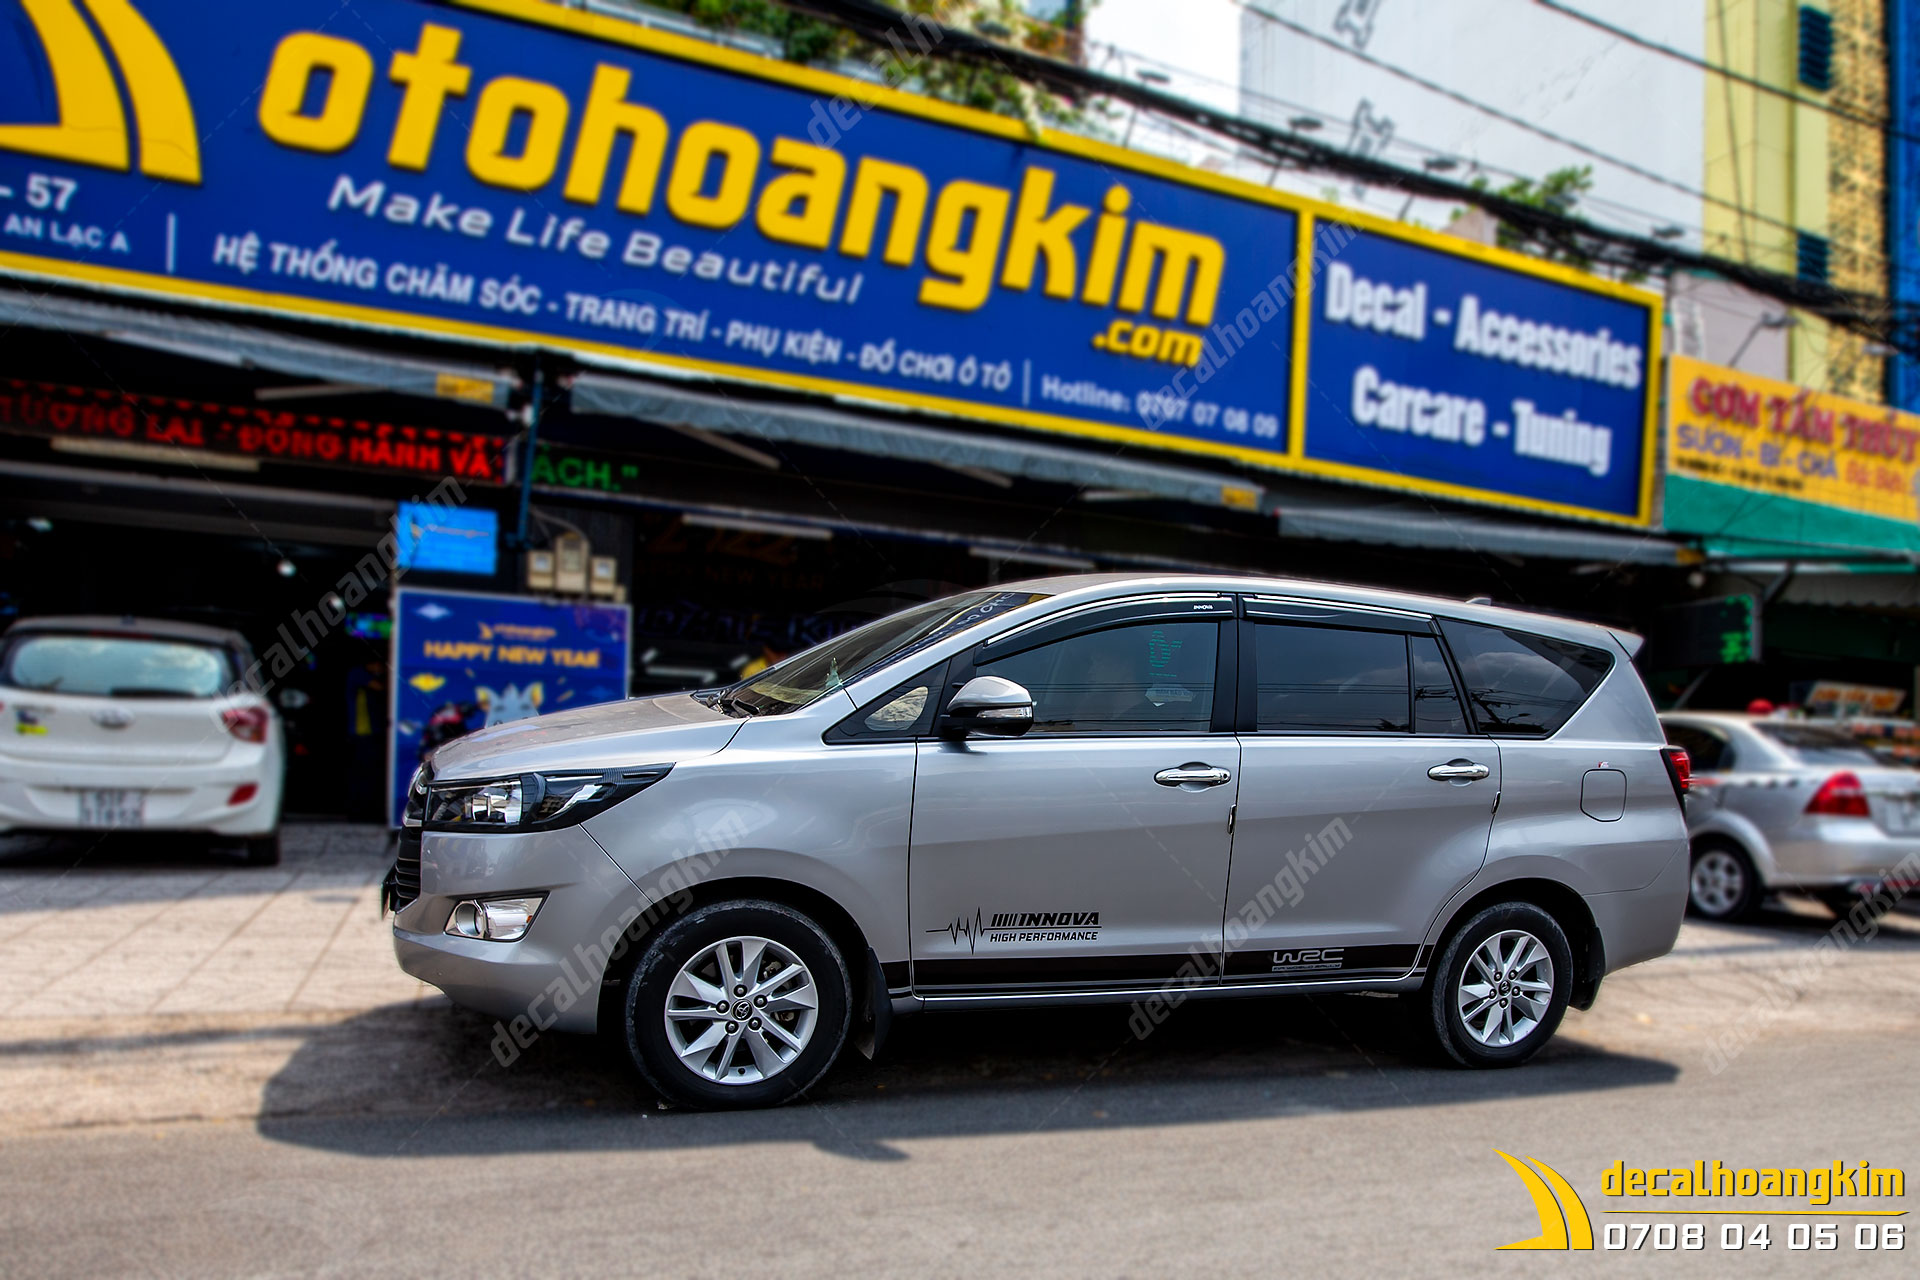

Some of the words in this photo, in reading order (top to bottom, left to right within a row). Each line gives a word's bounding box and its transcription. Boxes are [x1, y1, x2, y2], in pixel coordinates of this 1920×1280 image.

[26, 173, 77, 212] 57
[258, 22, 1226, 328] otohoangkim
[4, 213, 42, 239] AN
[50, 221, 103, 250] LẠC
[110, 230, 131, 254] A
[328, 173, 493, 238] Make
[505, 207, 611, 259] Life
[621, 229, 864, 304] Beautiful
[213, 231, 260, 275] HỆ
[269, 238, 379, 290] THỐNG
[479, 274, 543, 315] SÓC
[564, 292, 657, 333] TRANG
[664, 308, 710, 342] TRÍ
[725, 320, 781, 358] PHỤ
[783, 328, 843, 365] KIỆN
[957, 354, 978, 386] Ô
[982, 360, 1012, 392] TÔ
[1041, 374, 1131, 413] Hotline:
[1191, 400, 1220, 428] 07
[1222, 406, 1250, 434] 08
[1252, 412, 1280, 440] 09
[1091, 318, 1203, 369] .com
[1324, 261, 1428, 341] Decal
[1454, 295, 1642, 390] Accessories
[1352, 366, 1488, 446] Carcare
[1511, 398, 1613, 476] Tuning
[423, 640, 494, 662] HAPPY
[498, 644, 547, 664] NEW
[551, 648, 602, 669] YEAR
[989, 933, 1016, 943] HIGH
[1018, 931, 1099, 942] PERFORMANCE
[1018, 911, 1100, 927] INNOVA
